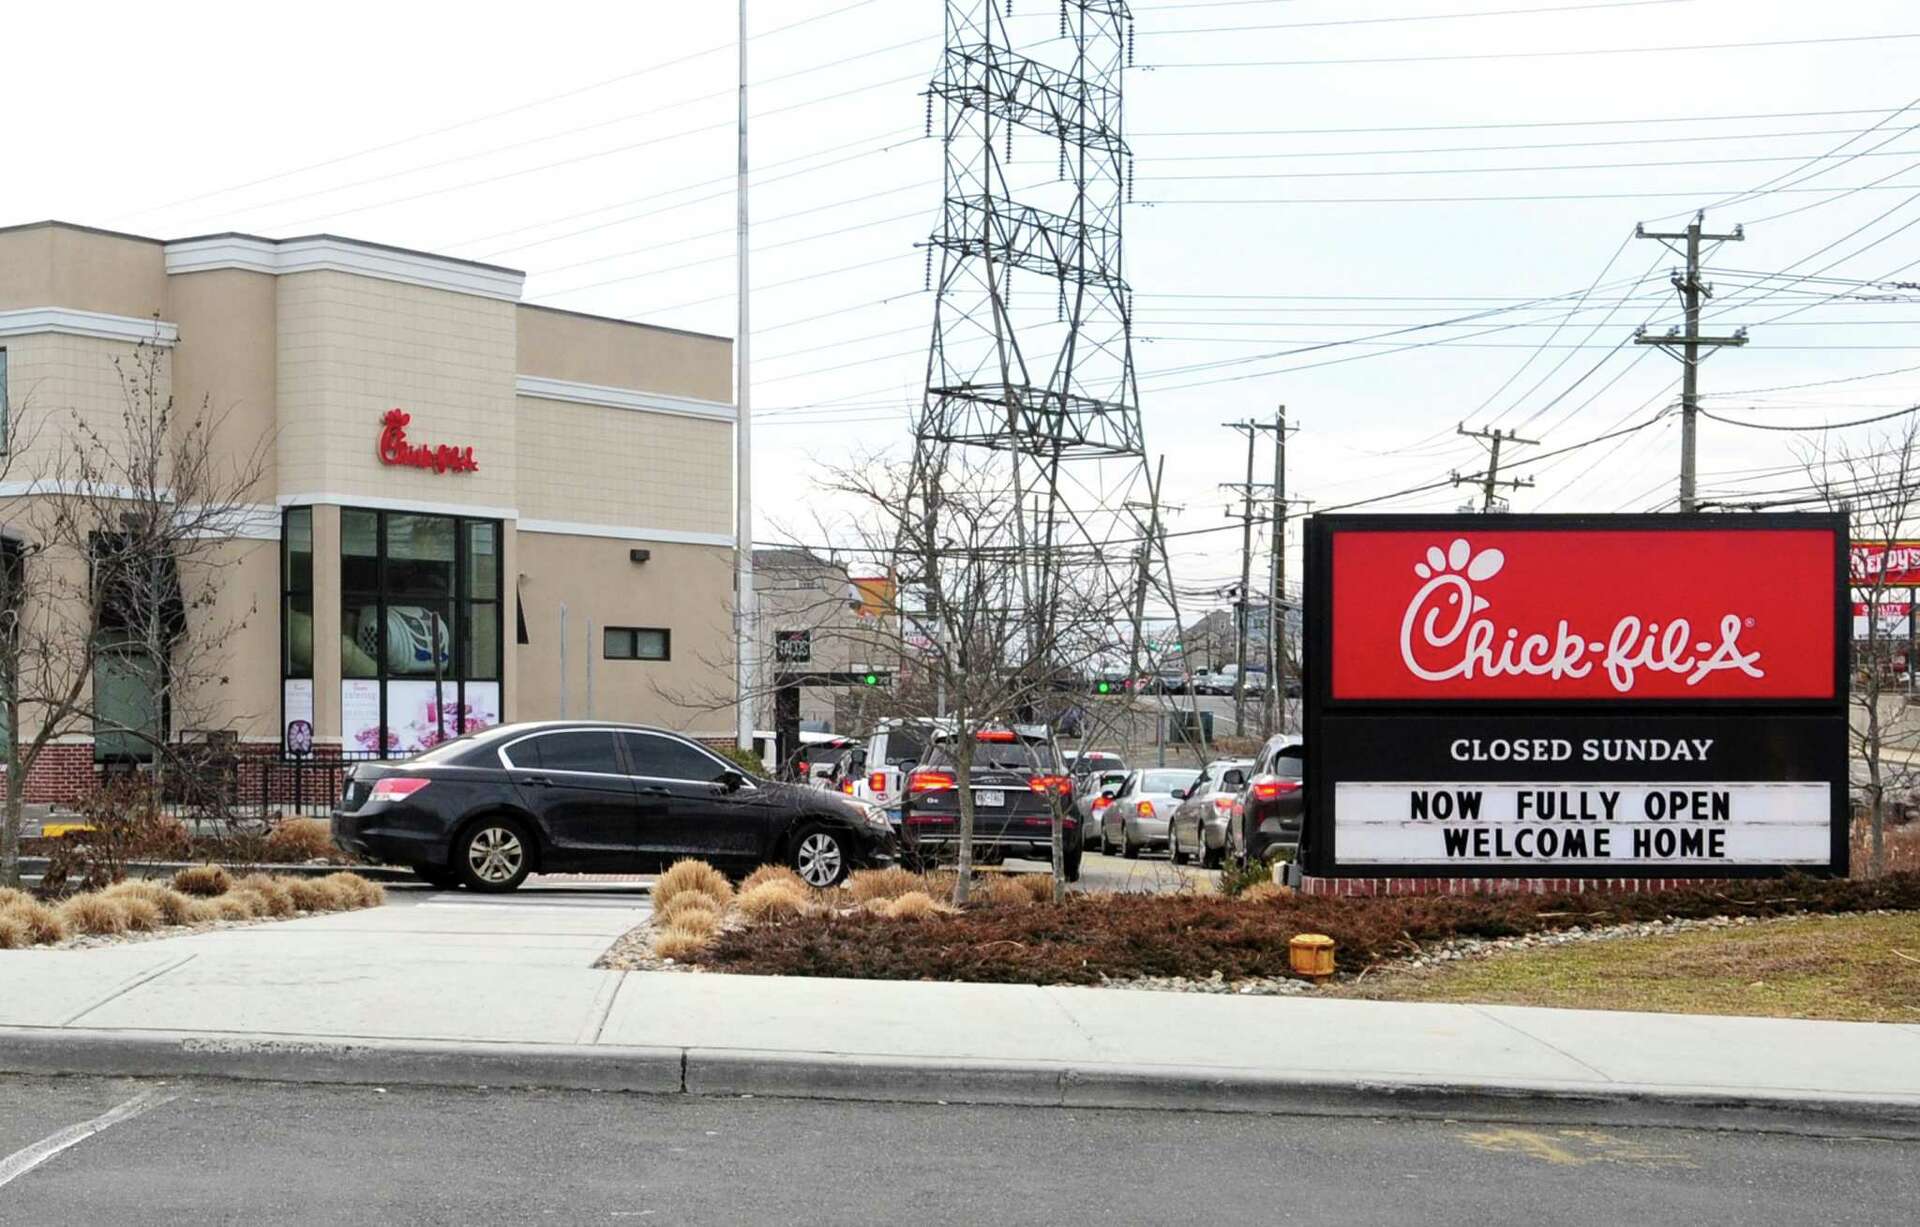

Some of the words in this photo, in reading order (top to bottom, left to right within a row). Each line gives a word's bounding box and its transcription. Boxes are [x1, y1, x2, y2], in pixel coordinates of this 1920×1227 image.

[1400, 573, 1765, 692] Chick-fil-A
[1450, 739, 1572, 761] CLOSED
[1582, 739, 1714, 761] SUNDAY
[1410, 791, 1482, 820] NOW
[1516, 791, 1620, 820] FULLY
[1644, 791, 1730, 820] OPEN
[1443, 828, 1611, 857] WELCOME
[1633, 828, 1726, 857] HOME
